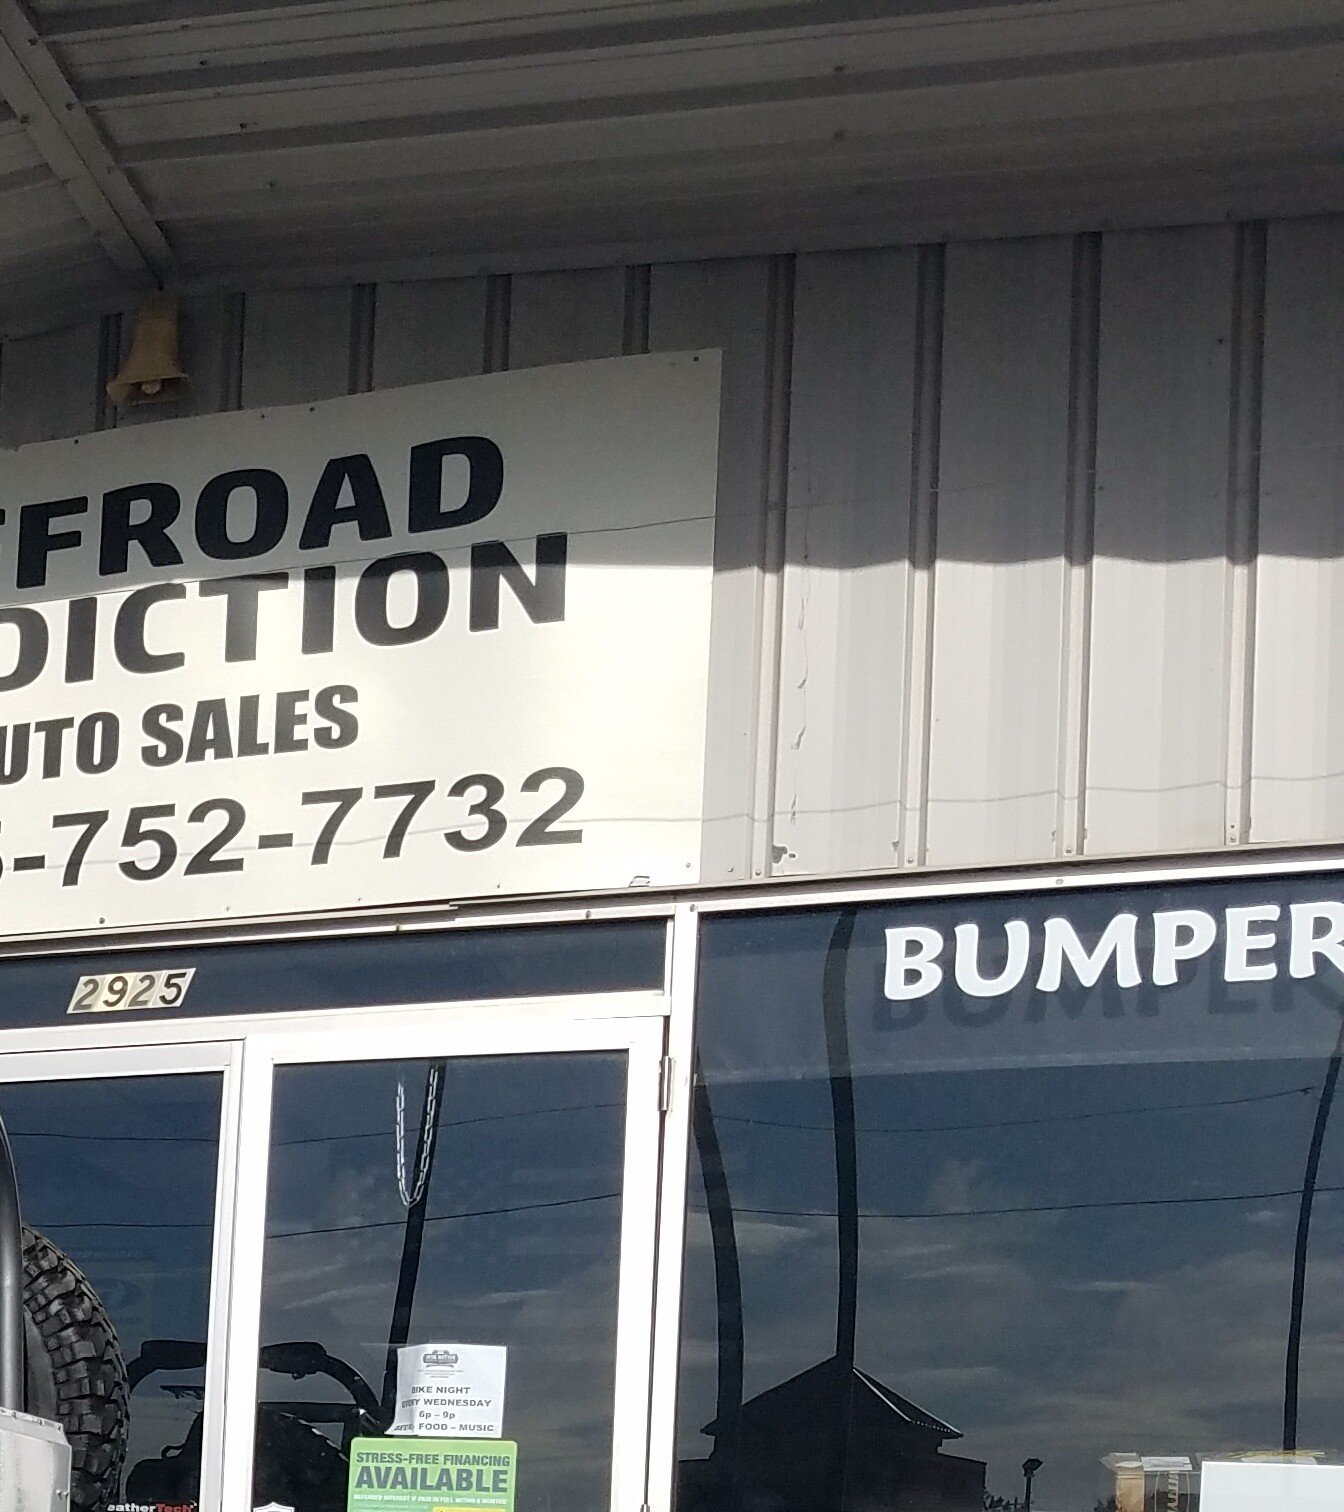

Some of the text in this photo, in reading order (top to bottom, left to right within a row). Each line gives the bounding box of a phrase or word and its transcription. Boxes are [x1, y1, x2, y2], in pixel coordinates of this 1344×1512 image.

[140, 683, 360, 766] SALES
[883, 901, 1344, 1002] BUMPER
[75, 972, 192, 1012] 2925
[436, 1386, 471, 1394] NIGHT
[423, 1398, 492, 1407] WEDNESDAY
[418, 1423, 448, 1431] FOOD
[458, 1423, 494, 1432] MUSIC
[356, 1452, 511, 1467] STRESS-FREE FINANCING
[355, 1465, 509, 1493] AVAILABLE
